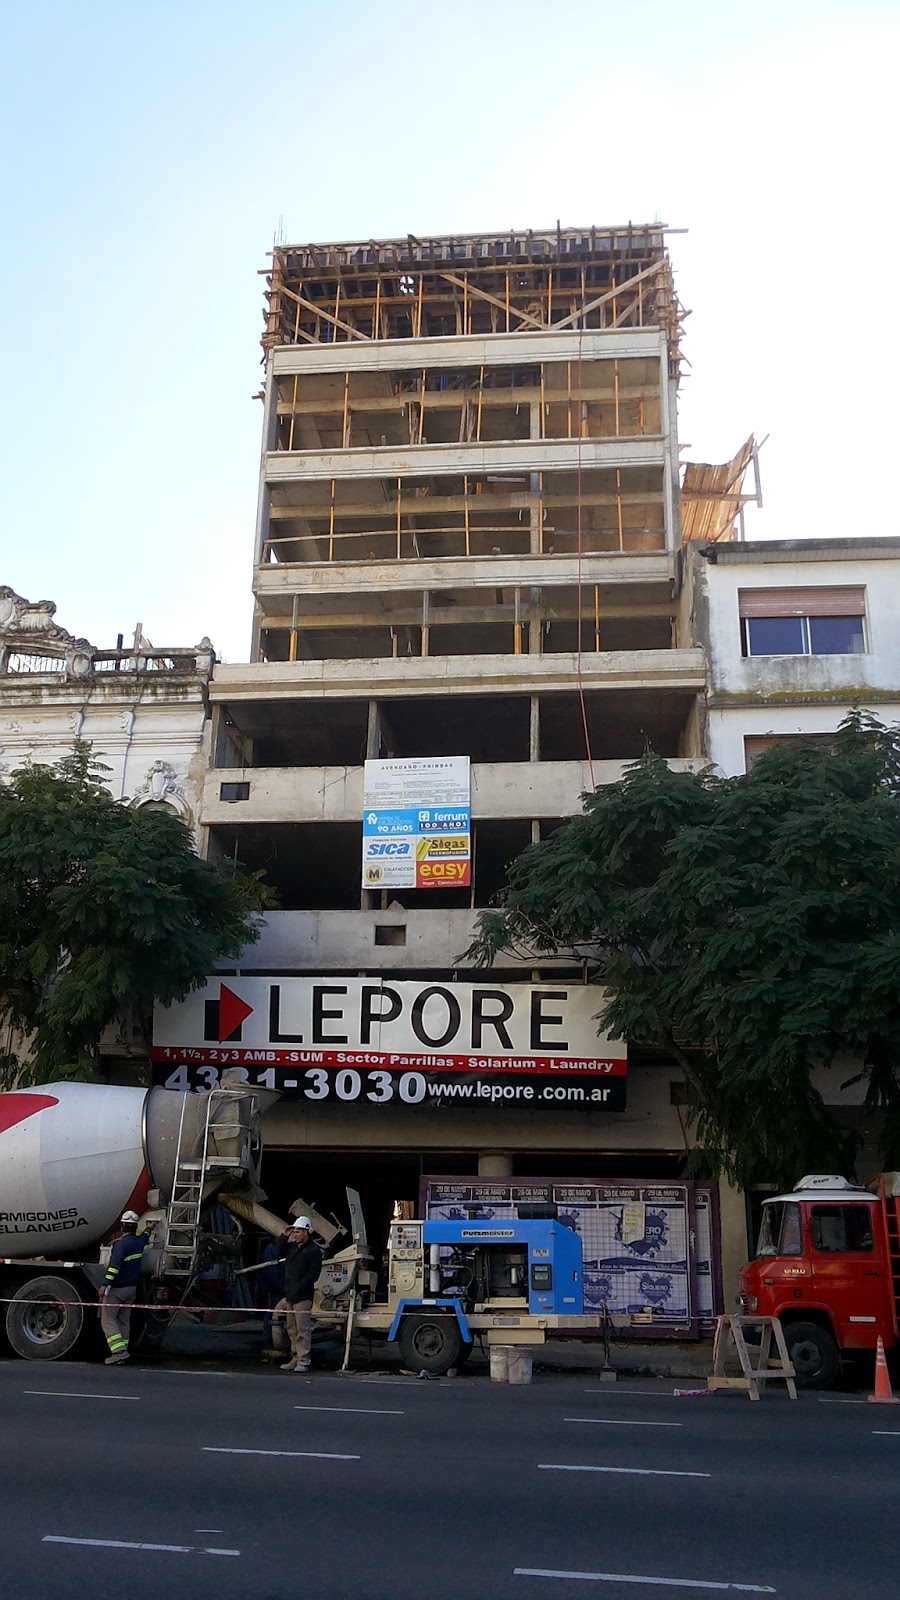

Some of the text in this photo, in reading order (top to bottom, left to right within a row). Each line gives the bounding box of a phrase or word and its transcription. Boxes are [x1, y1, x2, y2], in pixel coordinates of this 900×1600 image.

[434, 812, 468, 821] ferrum
[419, 863, 467, 878] easy
[269, 984, 569, 1051] LEPORE
[209, 1050, 218, 1059] 2
[244, 1051, 280, 1061] AMB.
[336, 1052, 386, 1064] Sector
[389, 1055, 454, 1067] Parrillas
[468, 1058, 536, 1068] Solarium
[550, 1059, 613, 1072] Laundry
